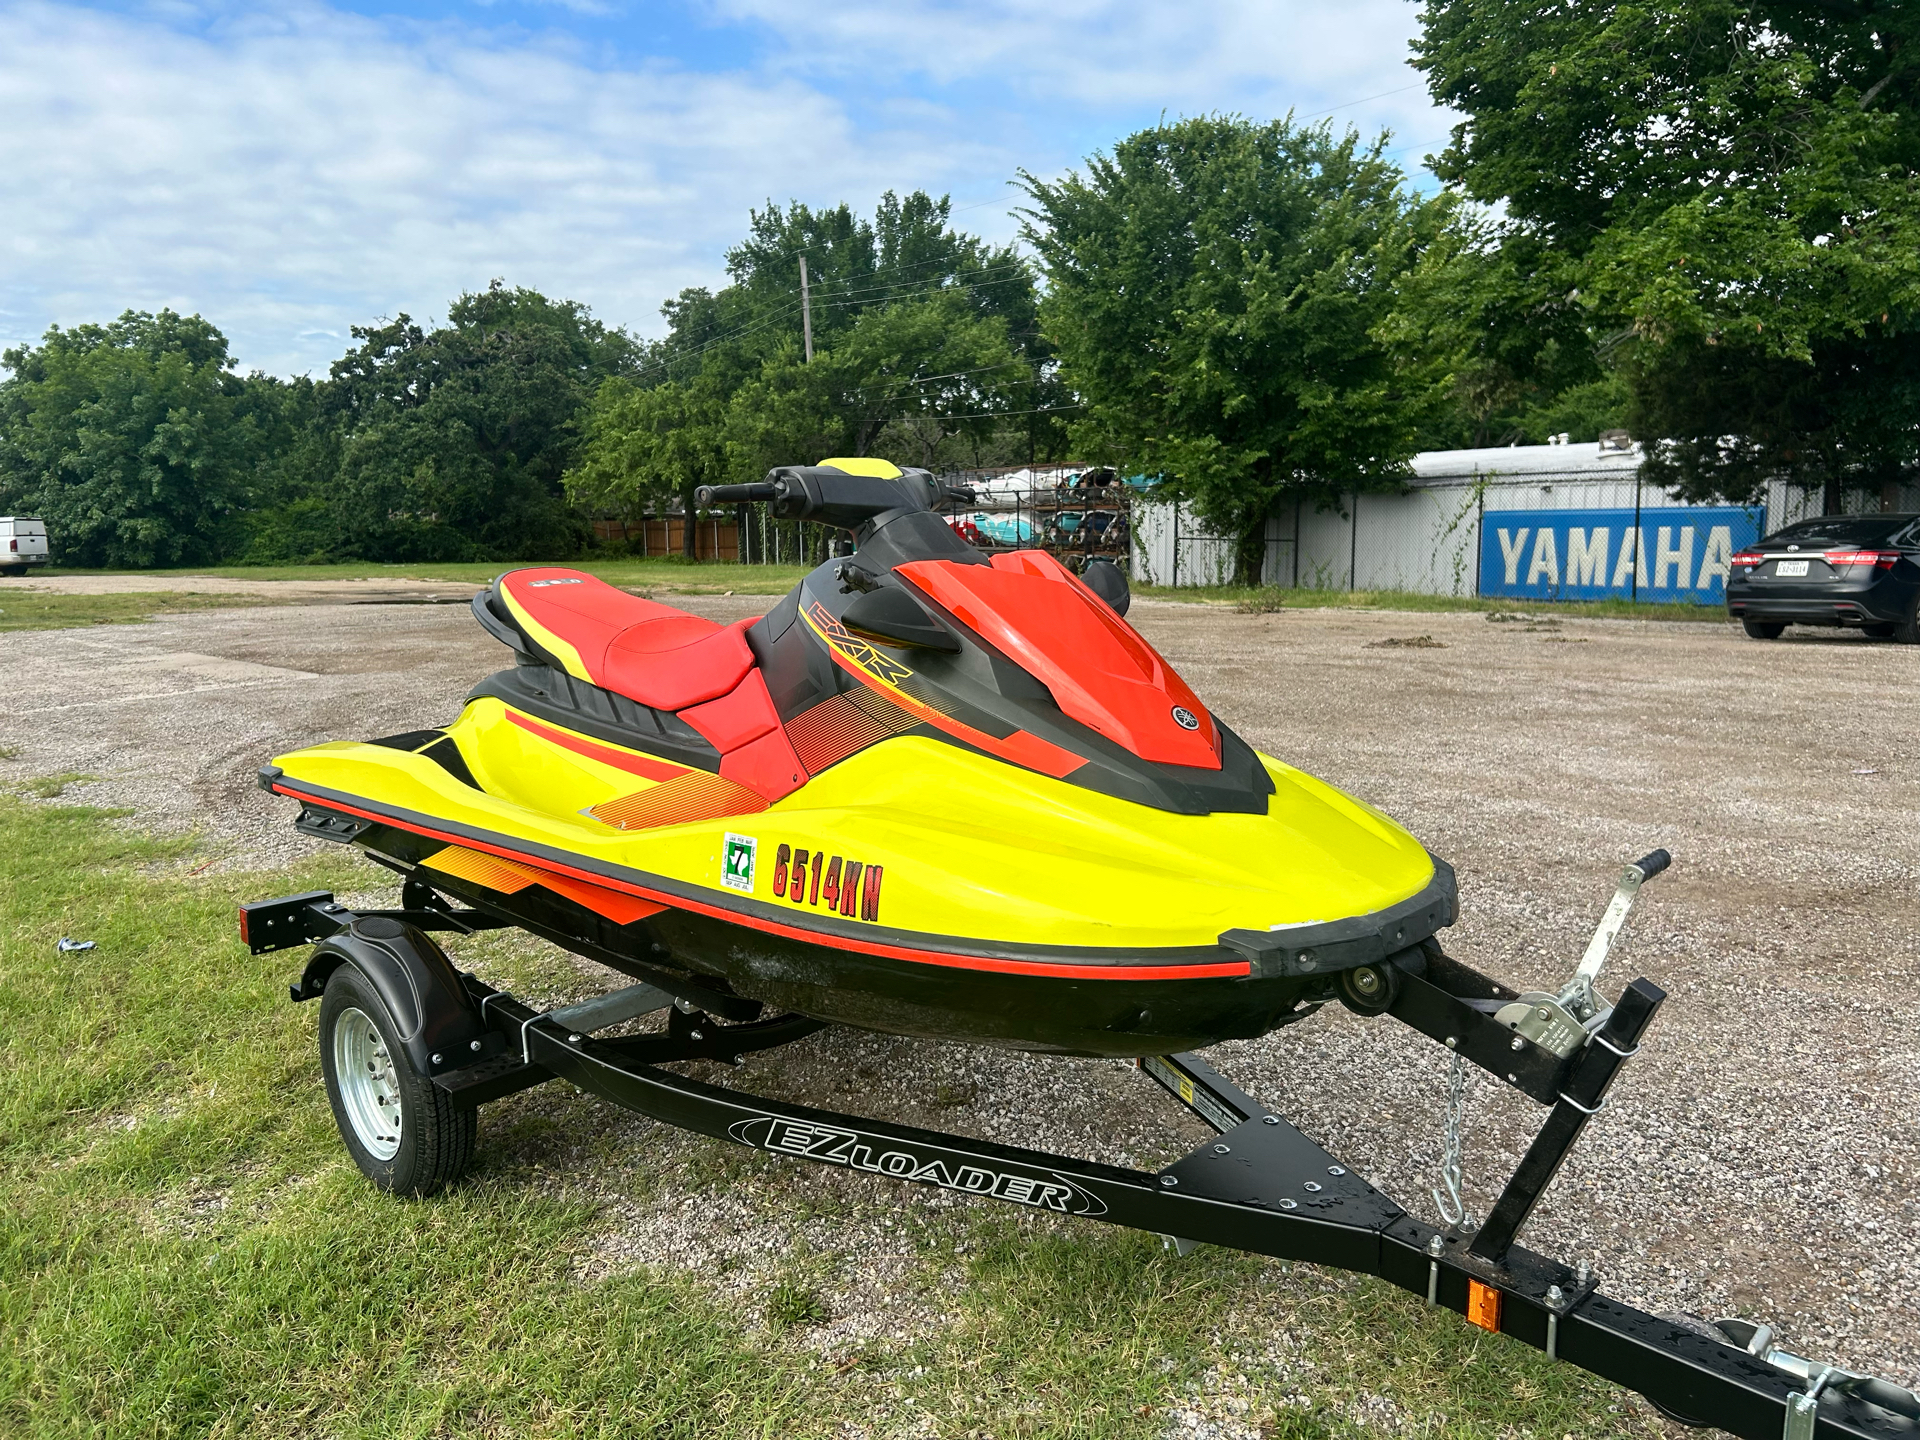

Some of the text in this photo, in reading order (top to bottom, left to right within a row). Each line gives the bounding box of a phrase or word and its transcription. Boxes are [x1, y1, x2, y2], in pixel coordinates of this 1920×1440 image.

[1497, 525, 1732, 590] YAMAHA
[806, 600, 915, 687] EXR
[734, 845, 745, 874] 7
[773, 843, 884, 922] 6514KN
